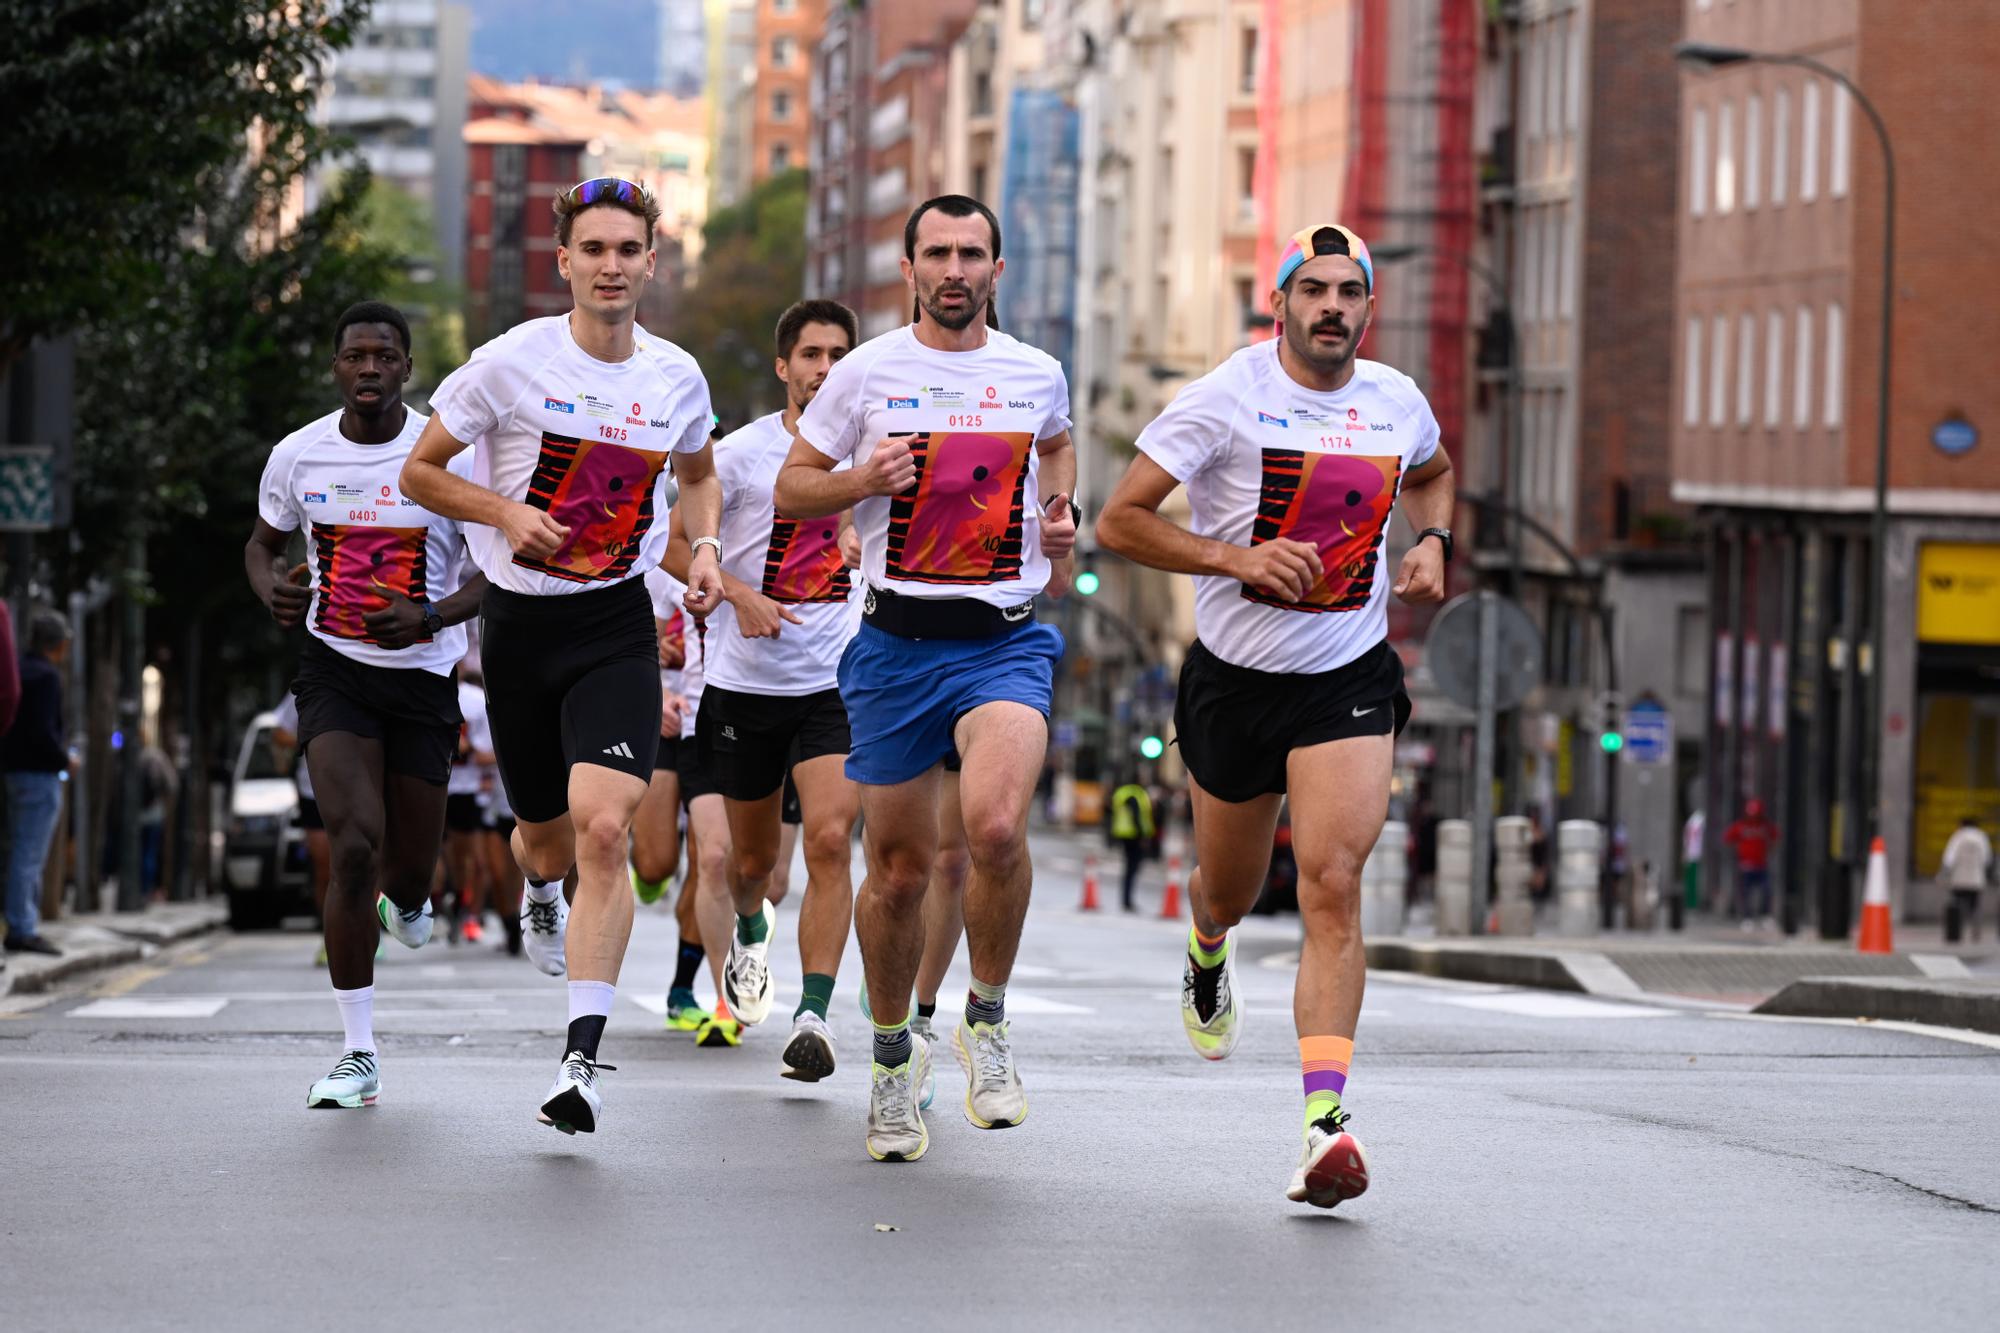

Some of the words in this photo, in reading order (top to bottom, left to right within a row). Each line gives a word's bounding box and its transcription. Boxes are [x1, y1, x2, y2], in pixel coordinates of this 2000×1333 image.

[549, 401, 569, 413] Deia
[892, 400, 913, 409] Deia
[978, 402, 1003, 410] Bilbao
[625, 416, 647, 428] Bilbao
[949, 415, 982, 427] 0125
[599, 424, 628, 441] 1875
[1319, 436, 1352, 449] 1174
[307, 494, 322, 504] Deia
[375, 499, 396, 507] Bilbao
[349, 510, 377, 522] 0403
[603, 542, 623, 557] 10
[982, 535, 1001, 552] 10
